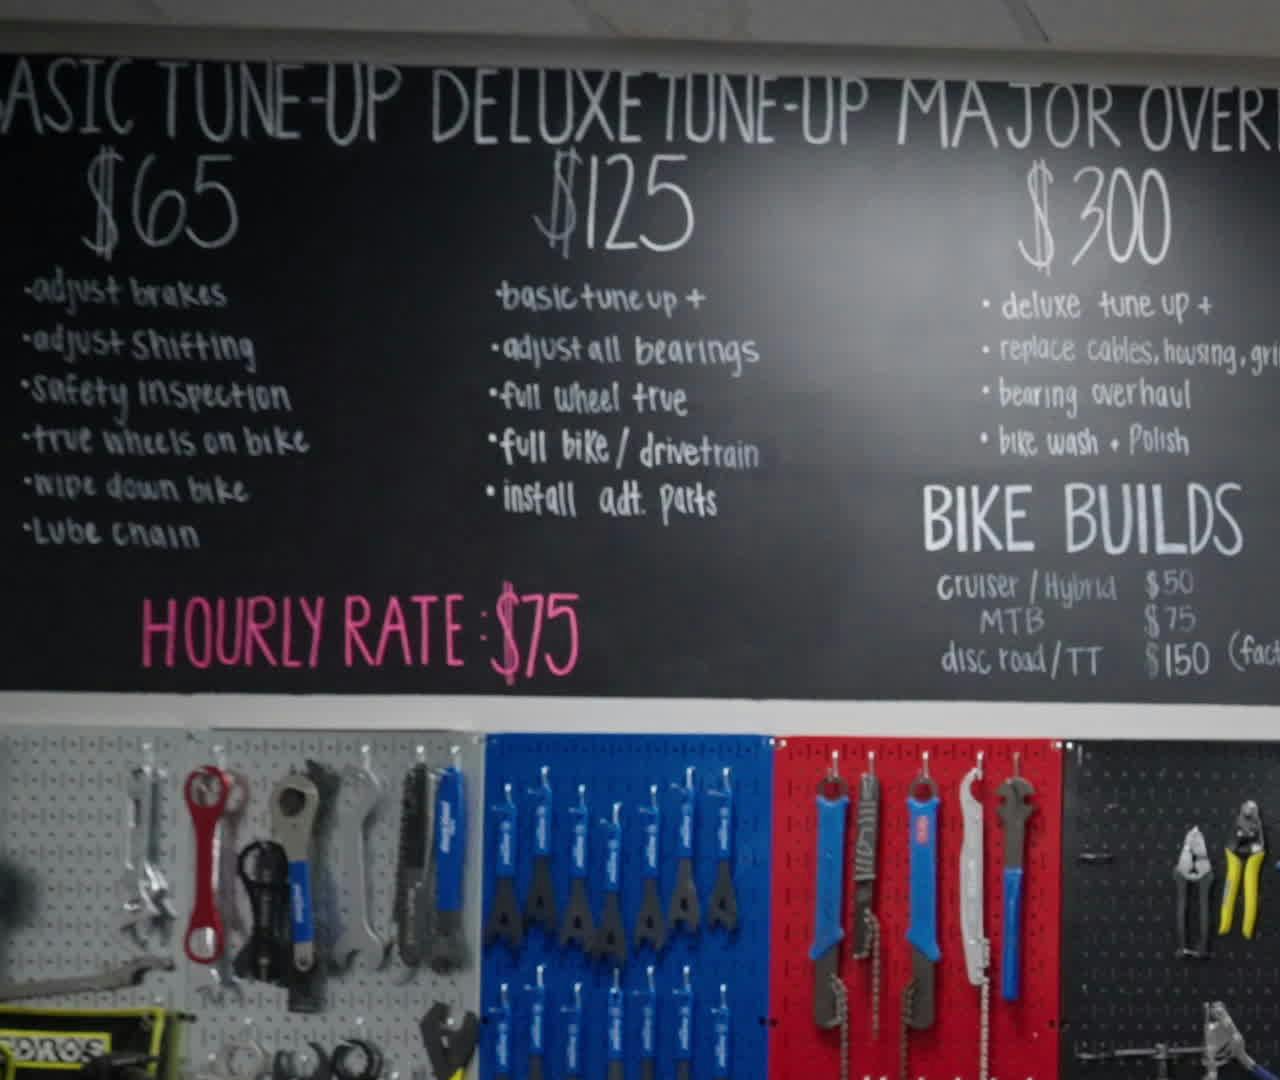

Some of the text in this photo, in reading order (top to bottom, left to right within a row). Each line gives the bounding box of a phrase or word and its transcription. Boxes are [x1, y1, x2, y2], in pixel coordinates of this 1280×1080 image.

[159, 60, 402, 145] TUNE-UP
[431, 68, 641, 144] DELUXE
[659, 71, 869, 145] TUNE-UP
[898, 78, 1121, 148] MAJOR
[82, 146, 240, 262] $65
[533, 147, 695, 260] $125
[31, 267, 228, 317] adjust brakes
[501, 280, 577, 311] basic
[1001, 290, 1081, 320] deluxe
[1098, 290, 1156, 319] tune
[1161, 293, 1190, 325] up
[31, 323, 126, 363] adjust
[502, 333, 761, 378] adjust all bearings
[1000, 335, 1077, 366] replace
[138, 378, 293, 413] inspection
[500, 380, 689, 416] full wheel true
[999, 377, 1192, 419] bearing overhaul
[31, 424, 311, 457] true wheels on bike
[500, 427, 547, 466] full
[639, 430, 761, 470] drivetrain
[999, 424, 1039, 458] bike
[1046, 427, 1100, 457] wash
[106, 470, 180, 502] down
[188, 474, 252, 504] bike
[503, 477, 577, 518] install
[659, 482, 718, 526] parts
[111, 520, 202, 550] chain
[922, 482, 1245, 556] BIKE BUILDS
[1145, 568, 1195, 600] $50
[141, 595, 325, 668] HOURLY
[490, 580, 581, 686] $75
[979, 603, 1197, 638] MTB $75
[941, 640, 992, 675] disc
[0, 1036, 105, 1063] DROS
